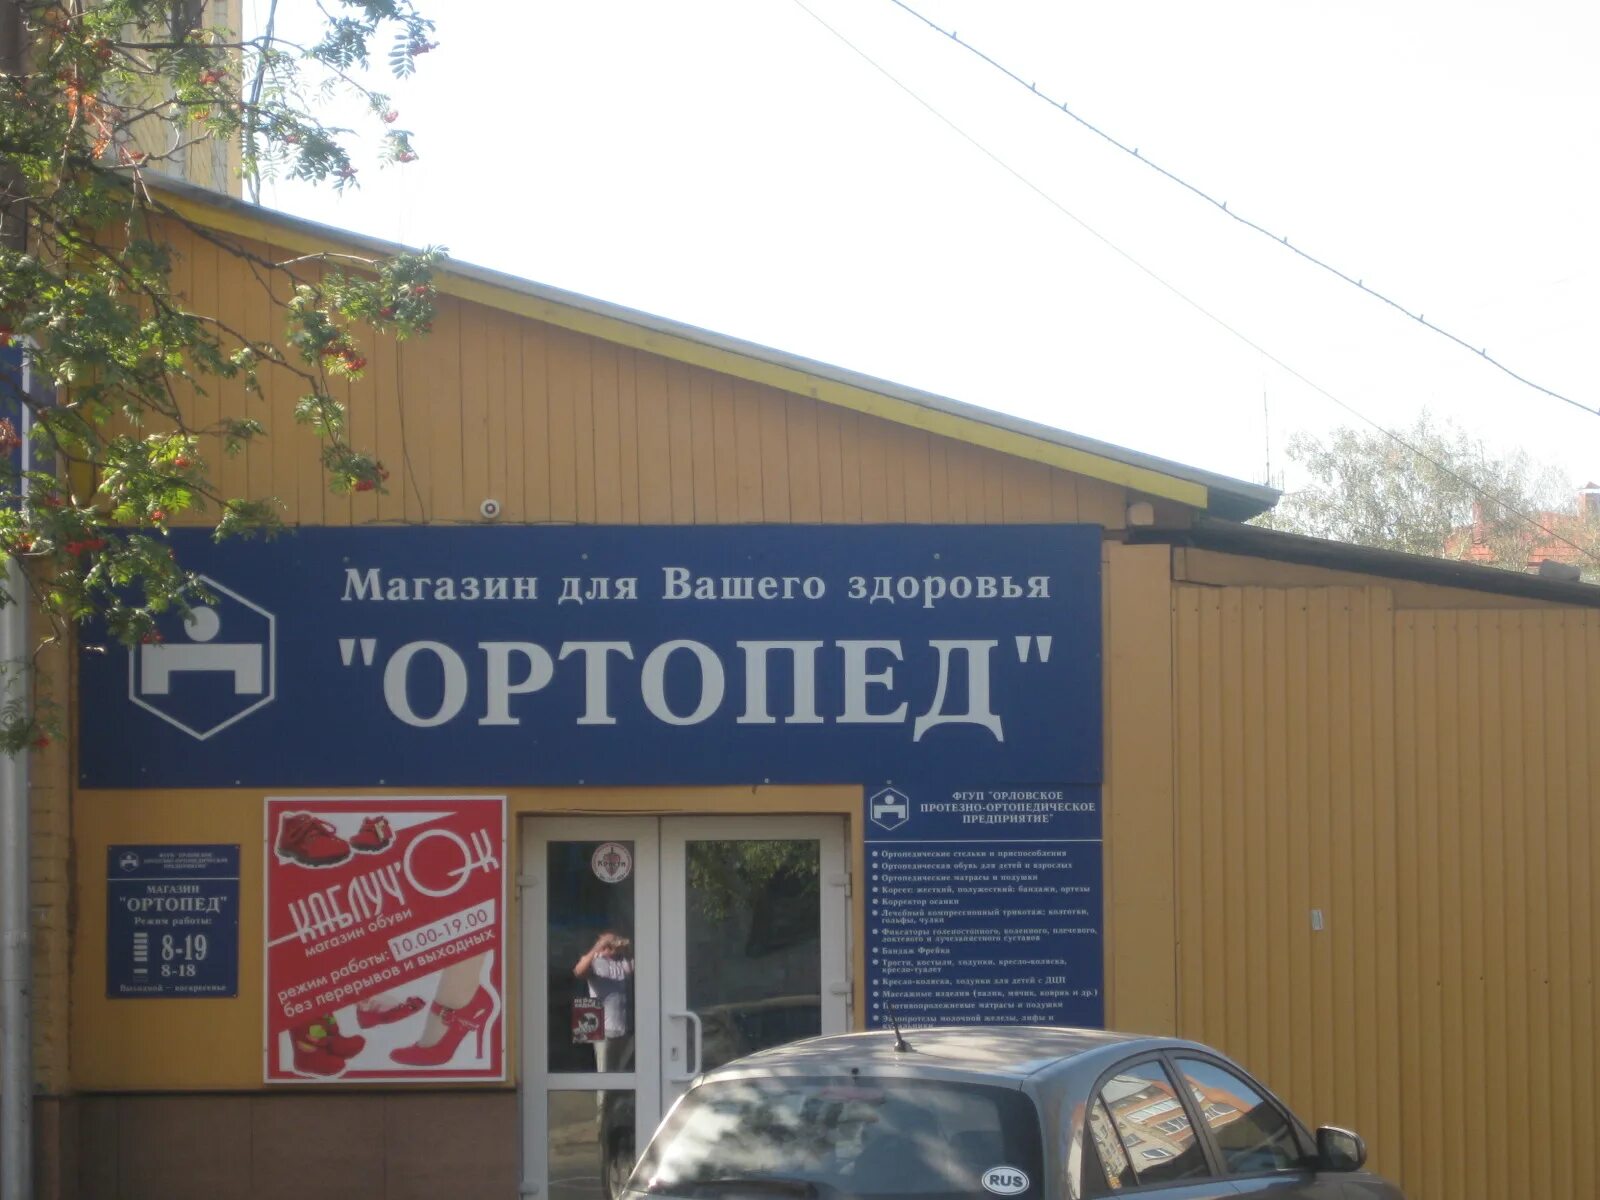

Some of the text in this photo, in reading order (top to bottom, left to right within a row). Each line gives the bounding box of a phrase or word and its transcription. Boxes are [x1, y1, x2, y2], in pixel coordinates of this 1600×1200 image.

[340, 567, 1051, 609] Магазин для Вашего здоровья
[338, 636, 1053, 742] "ОРТОПЕД"
[952, 790, 1064, 801] ФГУП "ОРЛОВСКОЕ
[920, 802, 1096, 813] ПРОТЕЗНО-ОРТОПЕДИЧЕСКОЕ
[962, 813, 1054, 824] ПРЕДПРИЯТИЕ"
[881, 850, 951, 859] Ортопедические
[997, 850, 1067, 859] приспособления
[881, 862, 951, 871] Ортопедическая
[953, 862, 978, 871] обувь
[998, 861, 1022, 870] детей
[1033, 863, 1073, 871] взрослых
[881, 874, 951, 883] Ортопедические
[953, 875, 990, 883] матрасы
[1000, 874, 1038, 882] подушки
[146, 884, 201, 894] МАГАЗИН
[1060, 886, 1091, 895] ортезы
[119, 896, 228, 913] "ОРТОПЕД"
[881, 898, 927, 907] Корректор
[881, 908, 925, 917] Лечебный
[927, 908, 1000, 918] компрессионный
[133, 916, 212, 927] Режим работы:
[918, 917, 945, 925] чулки
[305, 908, 413, 959] магазин обуви
[881, 928, 930, 936] Фиксаторы
[161, 934, 208, 961] 8-19
[881, 947, 915, 955] Бандаж
[277, 908, 489, 1004] режим работы: 10.00-19.00
[160, 964, 197, 977] 8-18
[283, 929, 496, 1018] без перерывов и выходных
[989, 1174, 1023, 1188] RUS
